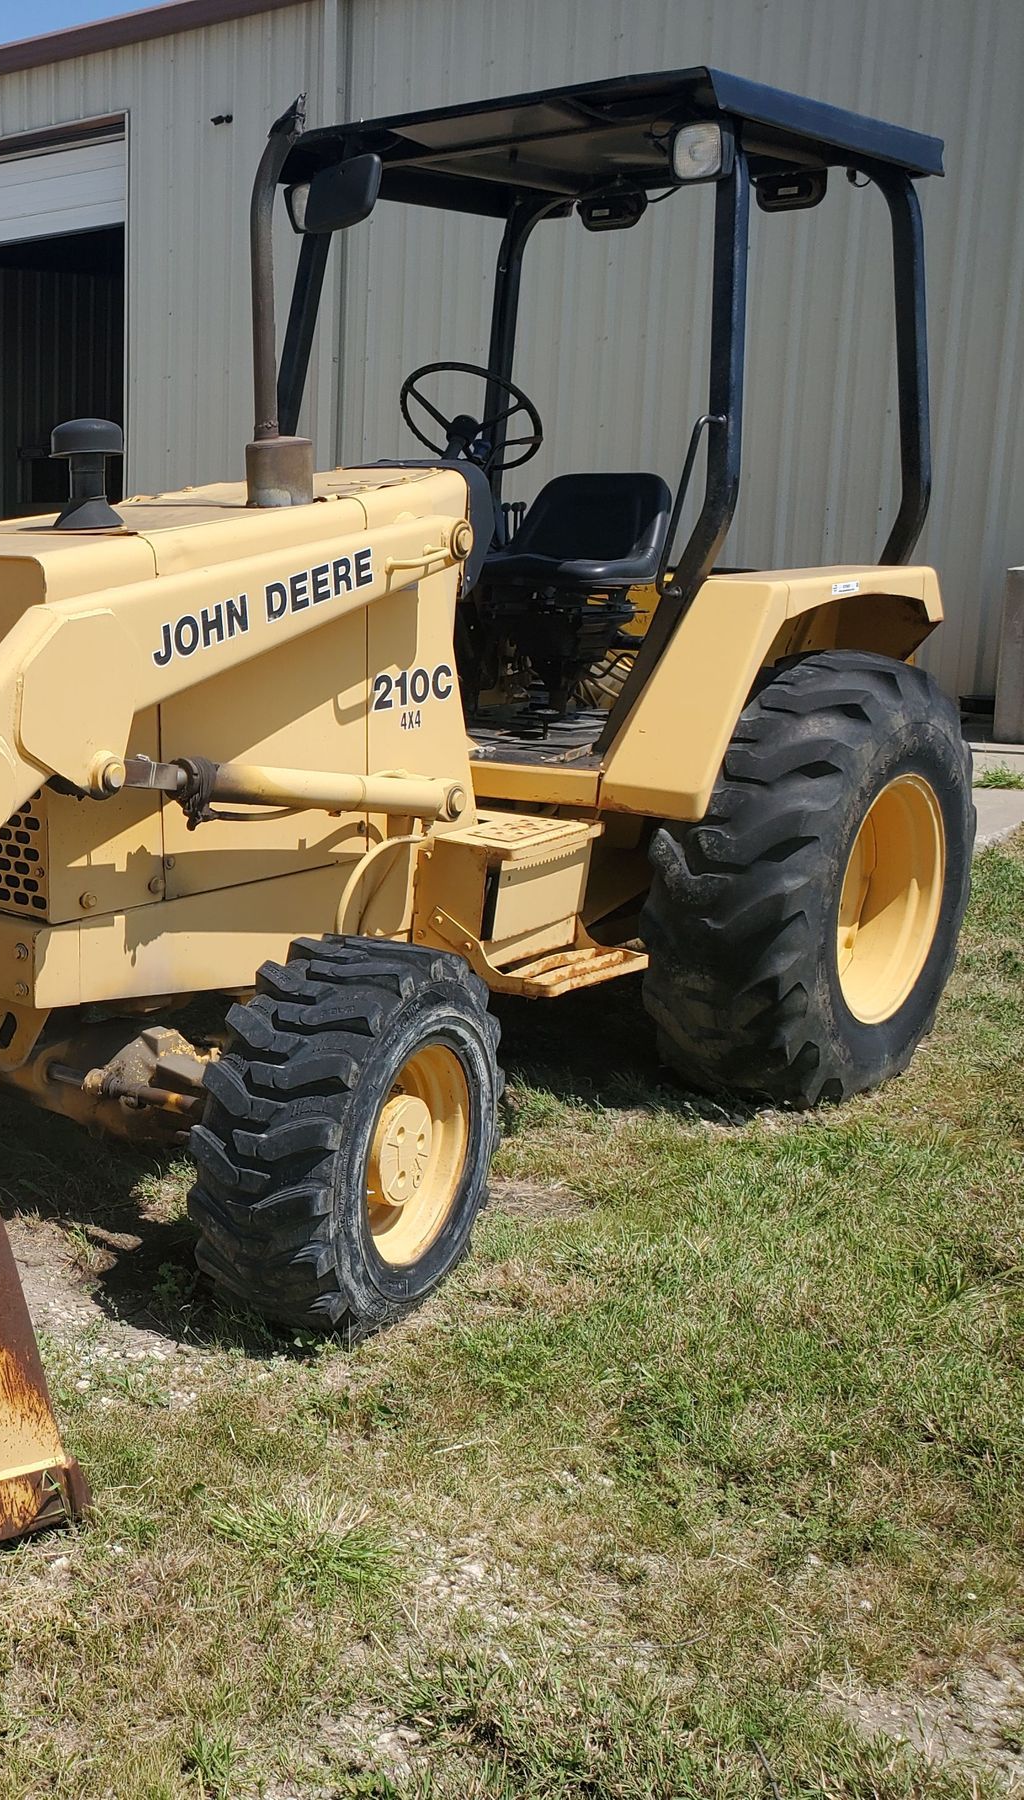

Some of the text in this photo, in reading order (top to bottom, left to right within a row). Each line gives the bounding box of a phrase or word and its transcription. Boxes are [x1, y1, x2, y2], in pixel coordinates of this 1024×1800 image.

[152, 547, 374, 668] JOHN DEERE
[372, 664, 454, 711] 210C
[400, 709, 422, 731] 4X4
